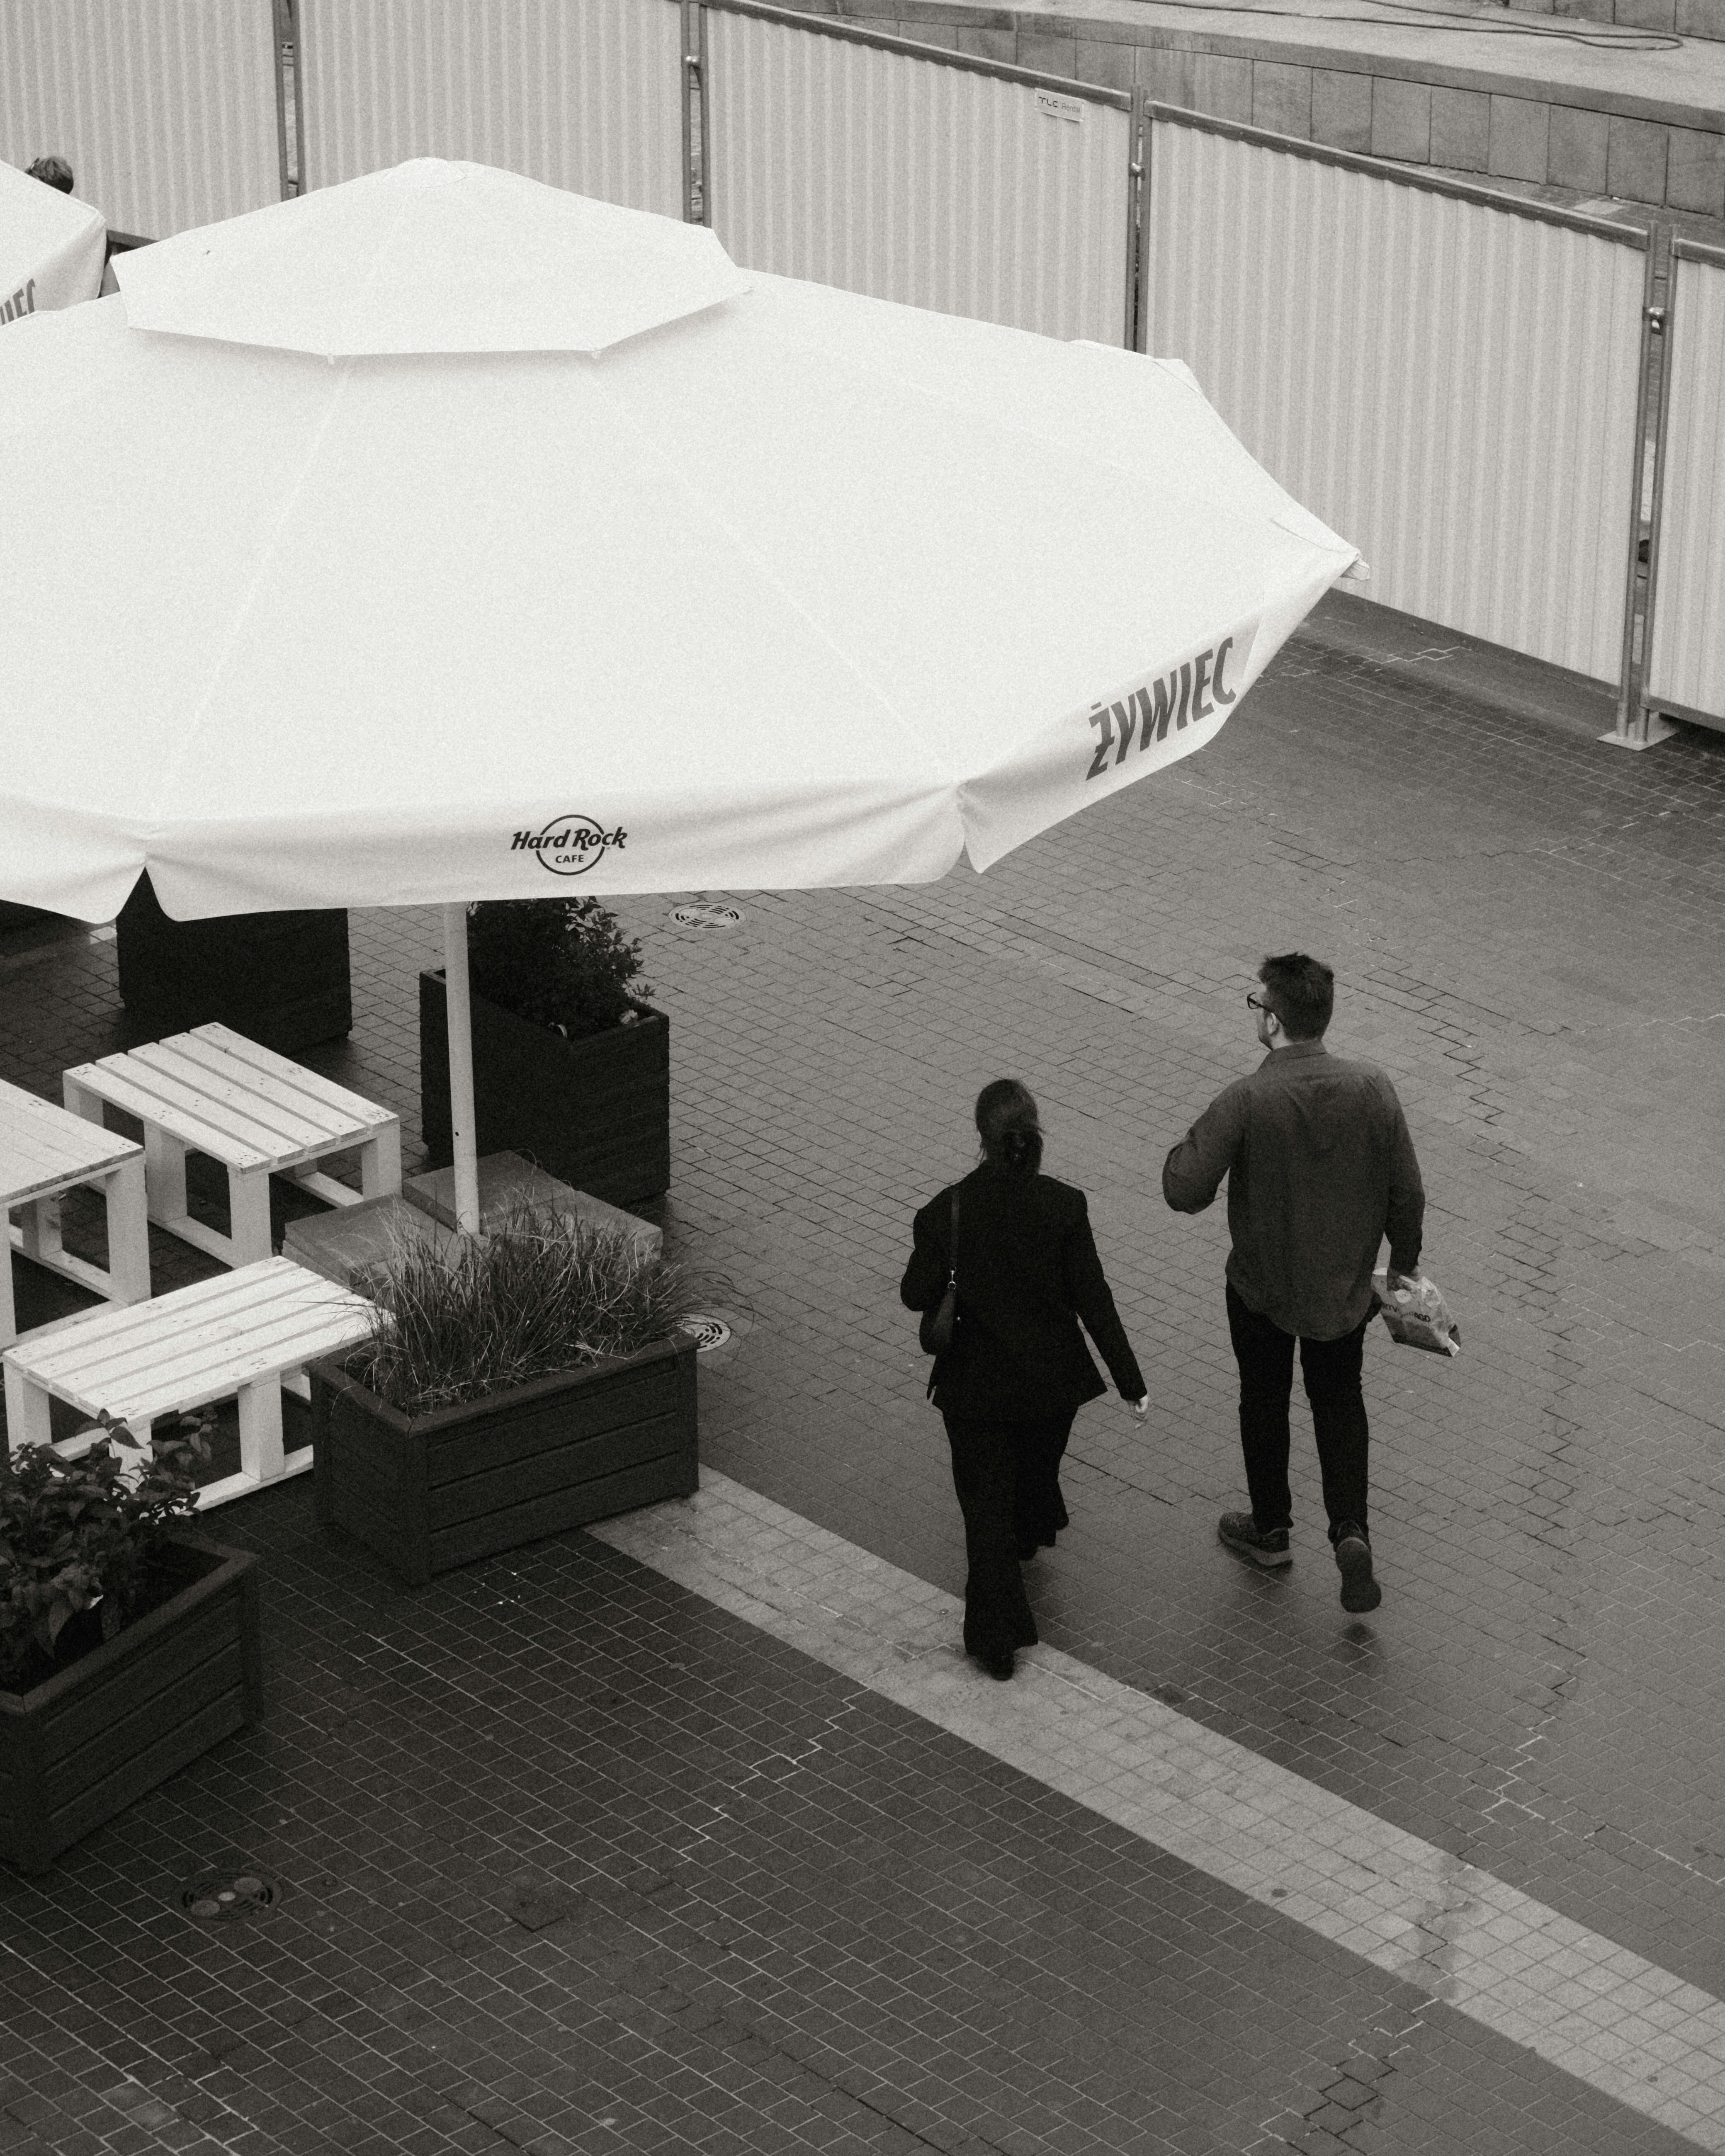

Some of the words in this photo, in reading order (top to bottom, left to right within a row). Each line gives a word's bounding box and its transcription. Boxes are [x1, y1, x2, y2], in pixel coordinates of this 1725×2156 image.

[1039, 96, 1058, 108] TLC
[1062, 102, 1080, 113] Rental
[0, 278, 36, 326] IEC
[1086, 636, 1236, 781] ŻYWIEC
[511, 829, 571, 850] Hard
[572, 826, 627, 850] Rock
[555, 855, 584, 863] CAFE
[1414, 1312, 1431, 1322] AGD
